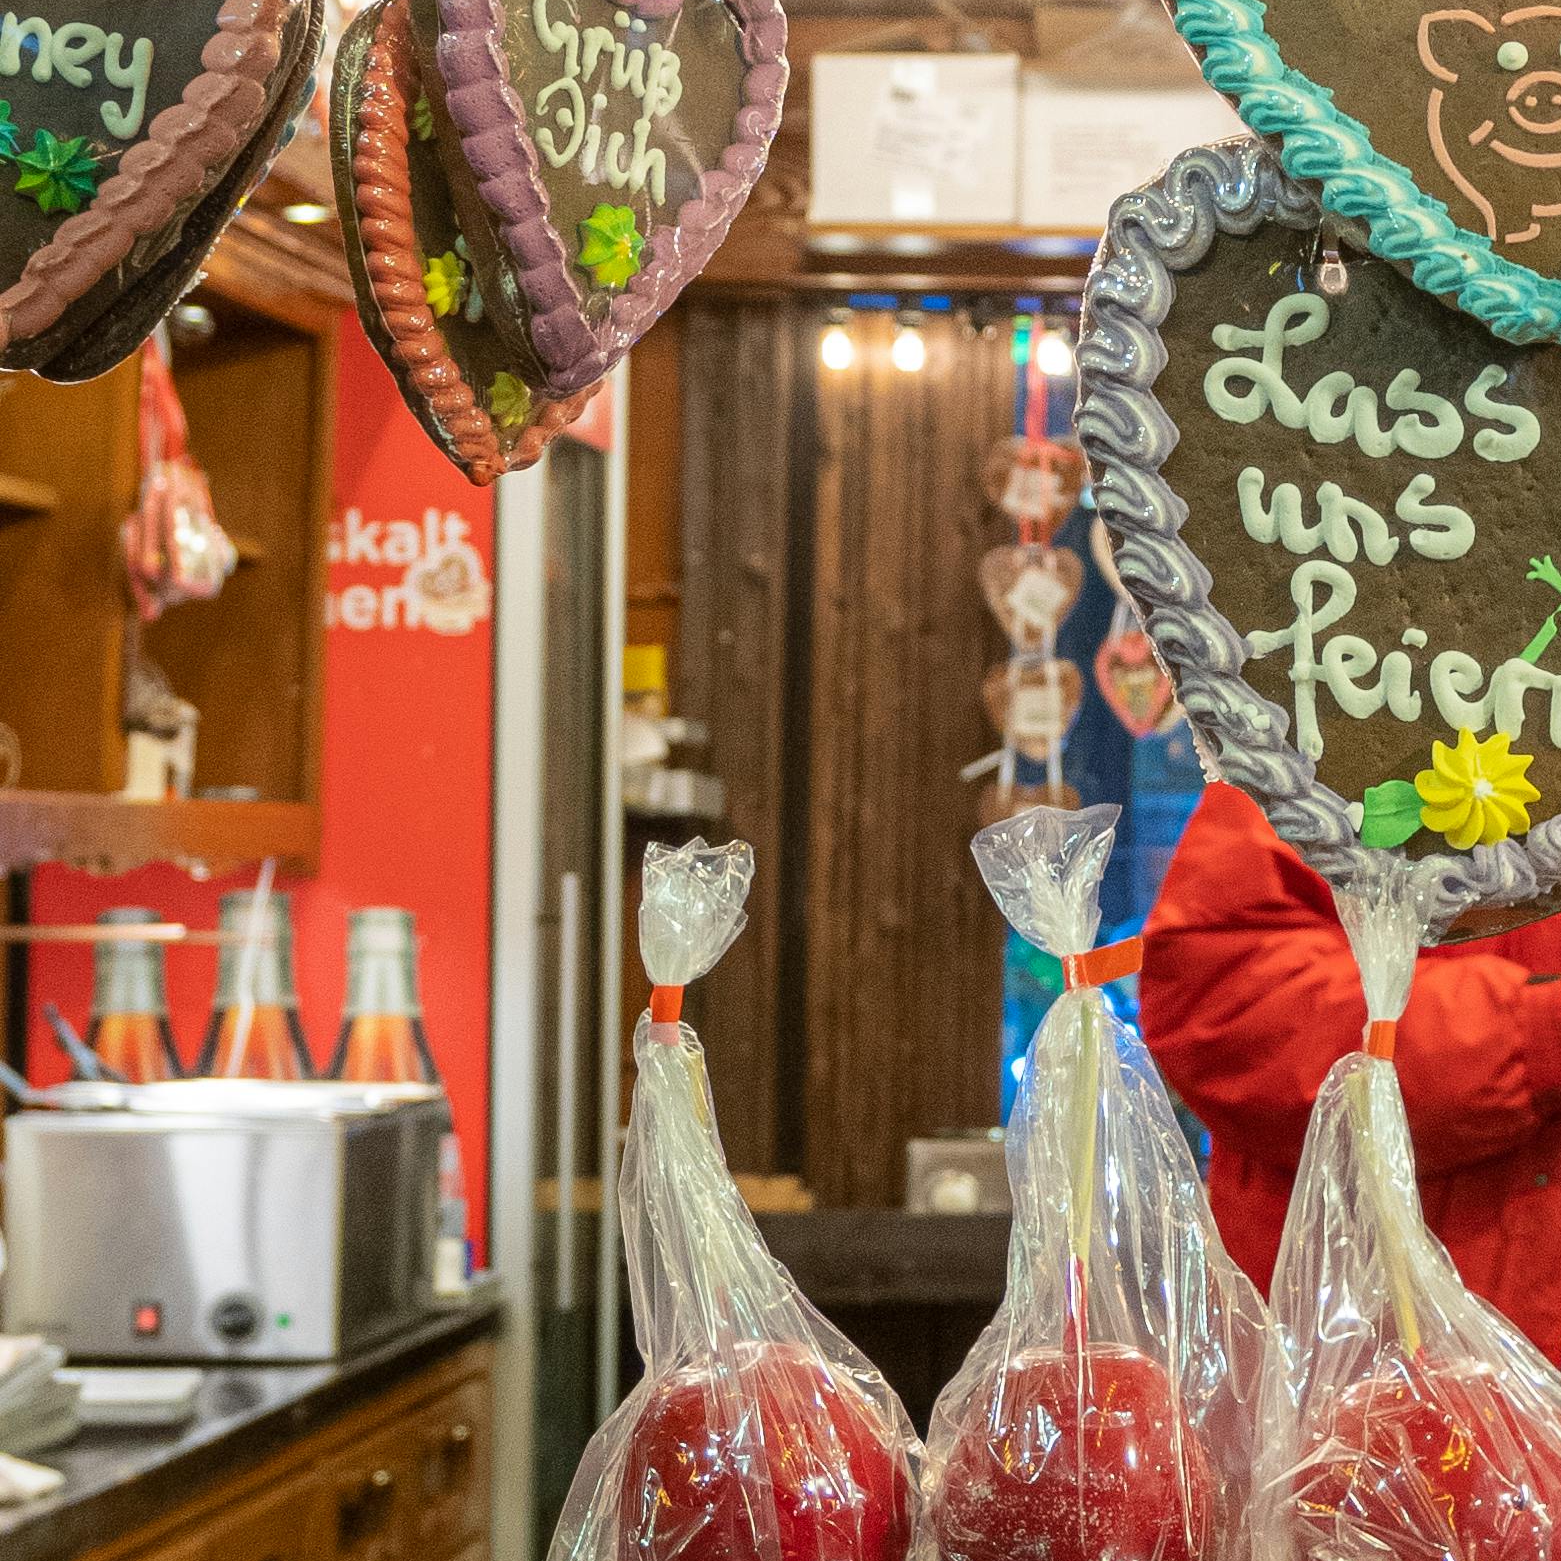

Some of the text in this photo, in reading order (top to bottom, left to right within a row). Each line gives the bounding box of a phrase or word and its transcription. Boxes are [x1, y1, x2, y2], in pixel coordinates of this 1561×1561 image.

[0, 11, 154, 140] ney
[535, 77, 666, 206] Dich
[1204, 291, 1542, 462] Lass
[1237, 466, 1476, 566] uns
